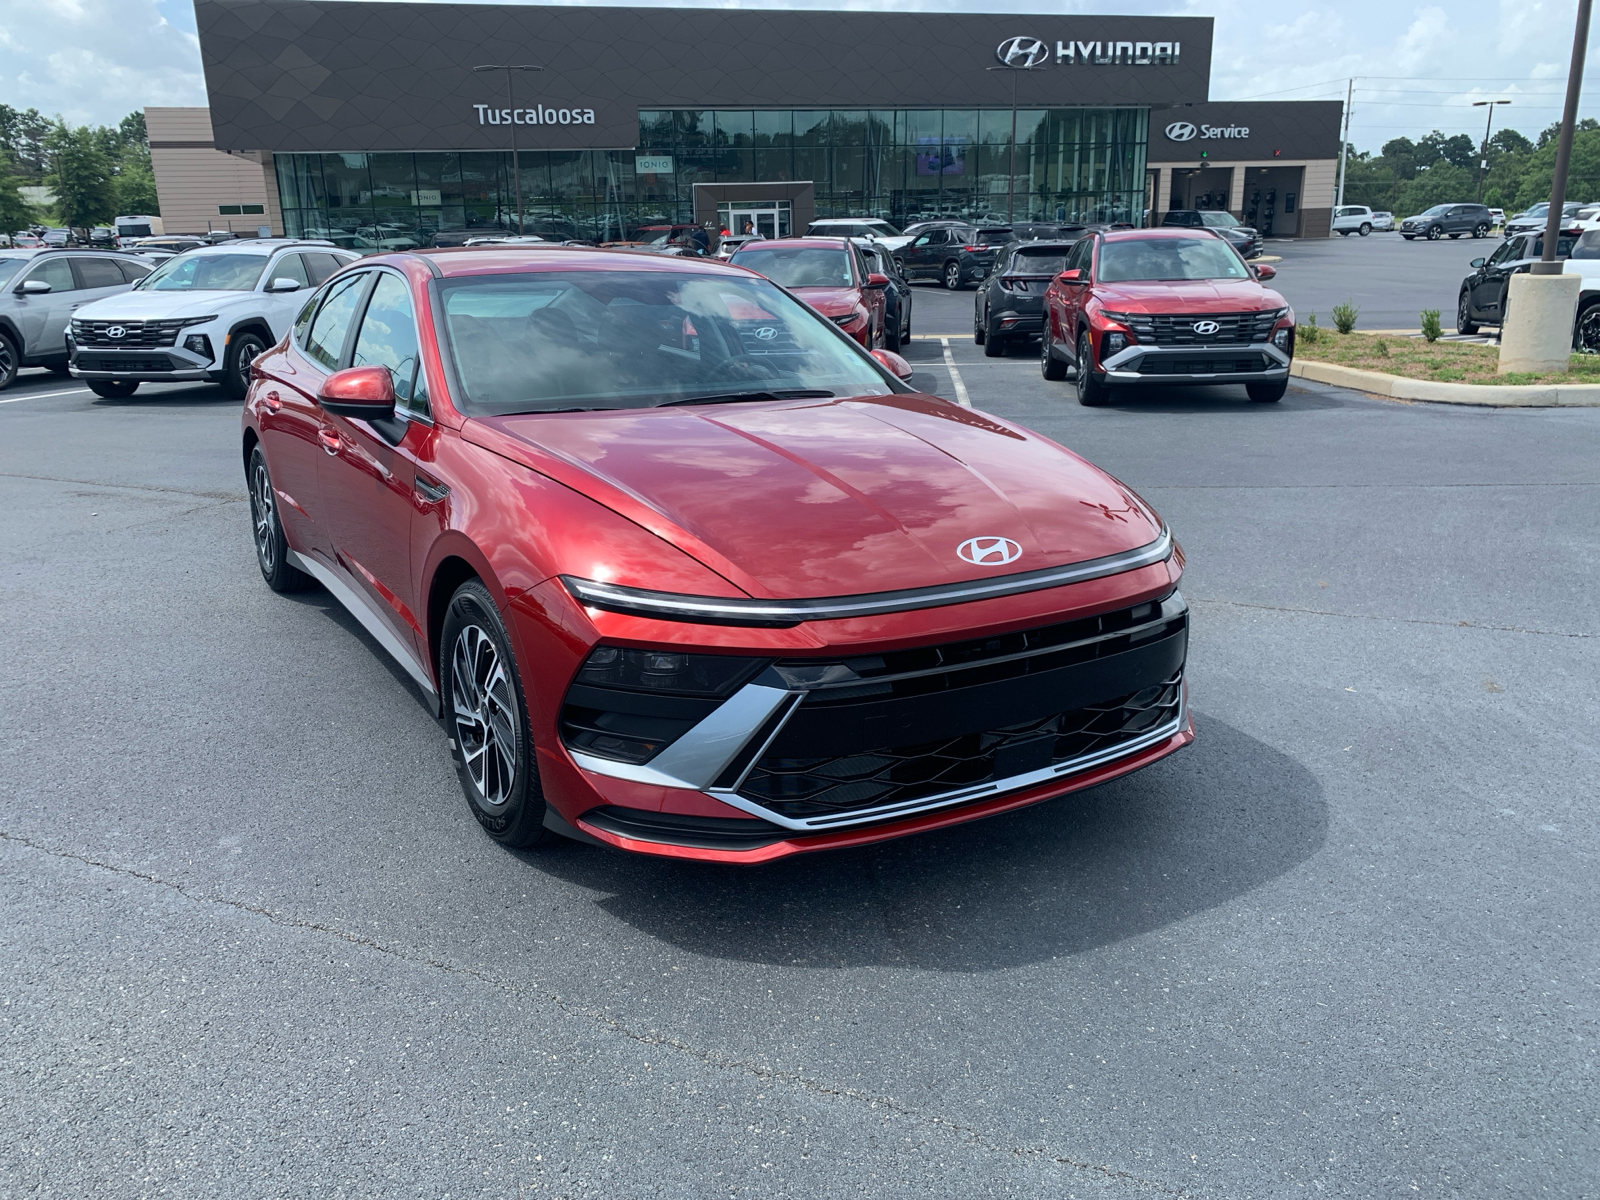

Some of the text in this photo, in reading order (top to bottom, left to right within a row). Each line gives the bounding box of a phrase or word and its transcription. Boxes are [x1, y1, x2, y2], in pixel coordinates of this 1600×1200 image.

[1055, 41, 1181, 65] HYUNDAI
[472, 104, 595, 125] Tuscaloosa
[1200, 124, 1250, 139] Service
